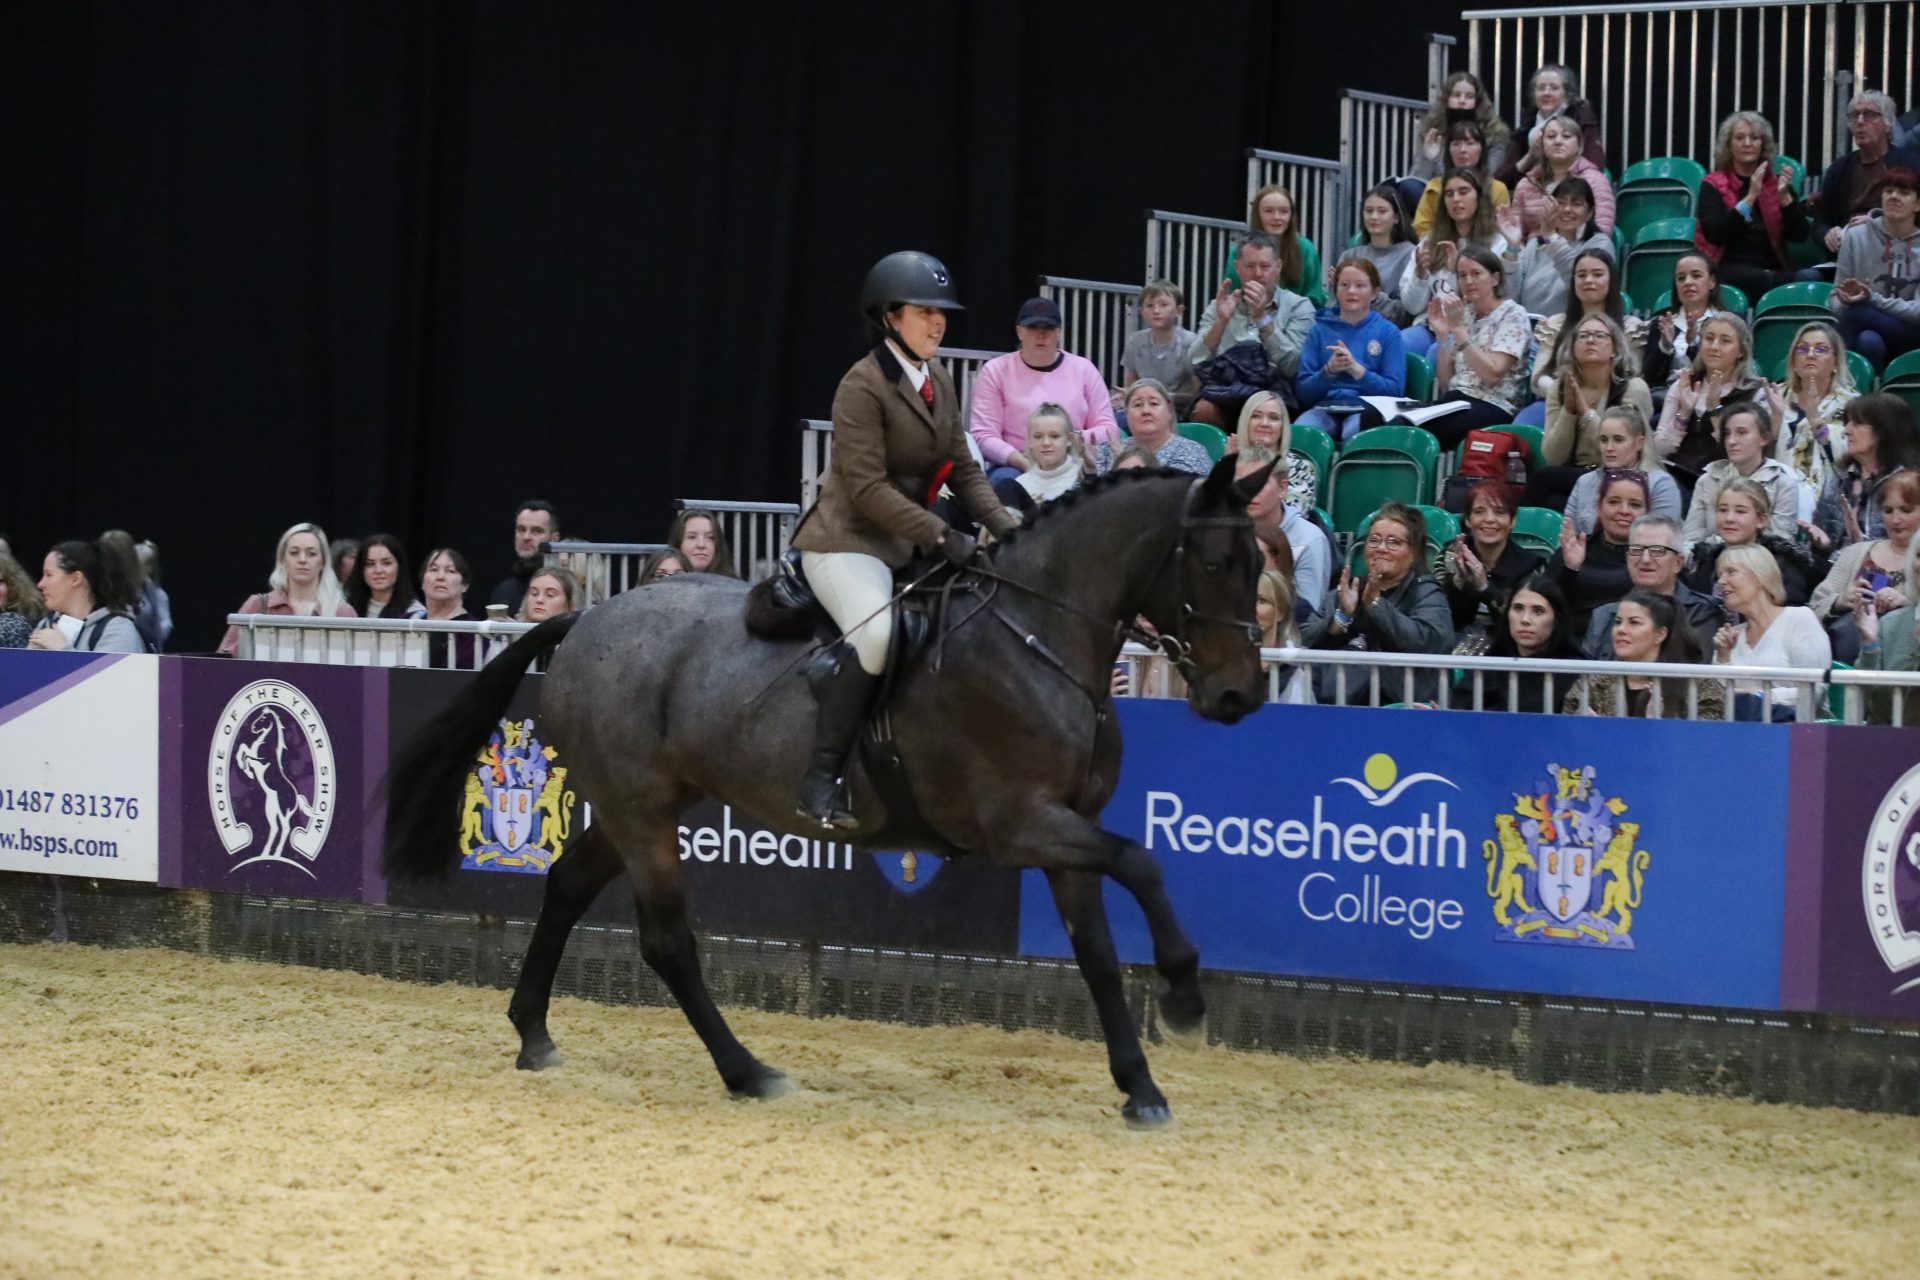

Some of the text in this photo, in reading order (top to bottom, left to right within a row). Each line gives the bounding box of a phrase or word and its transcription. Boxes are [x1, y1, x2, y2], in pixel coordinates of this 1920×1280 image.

[214, 688, 329, 833] HORSE OF THE YEAR SHOW
[0, 788, 139, 820] 1487 831376
[1144, 791, 1466, 869] Reaseheath
[1873, 790, 1910, 940] HORSE OF
[1299, 871, 1464, 940] College
